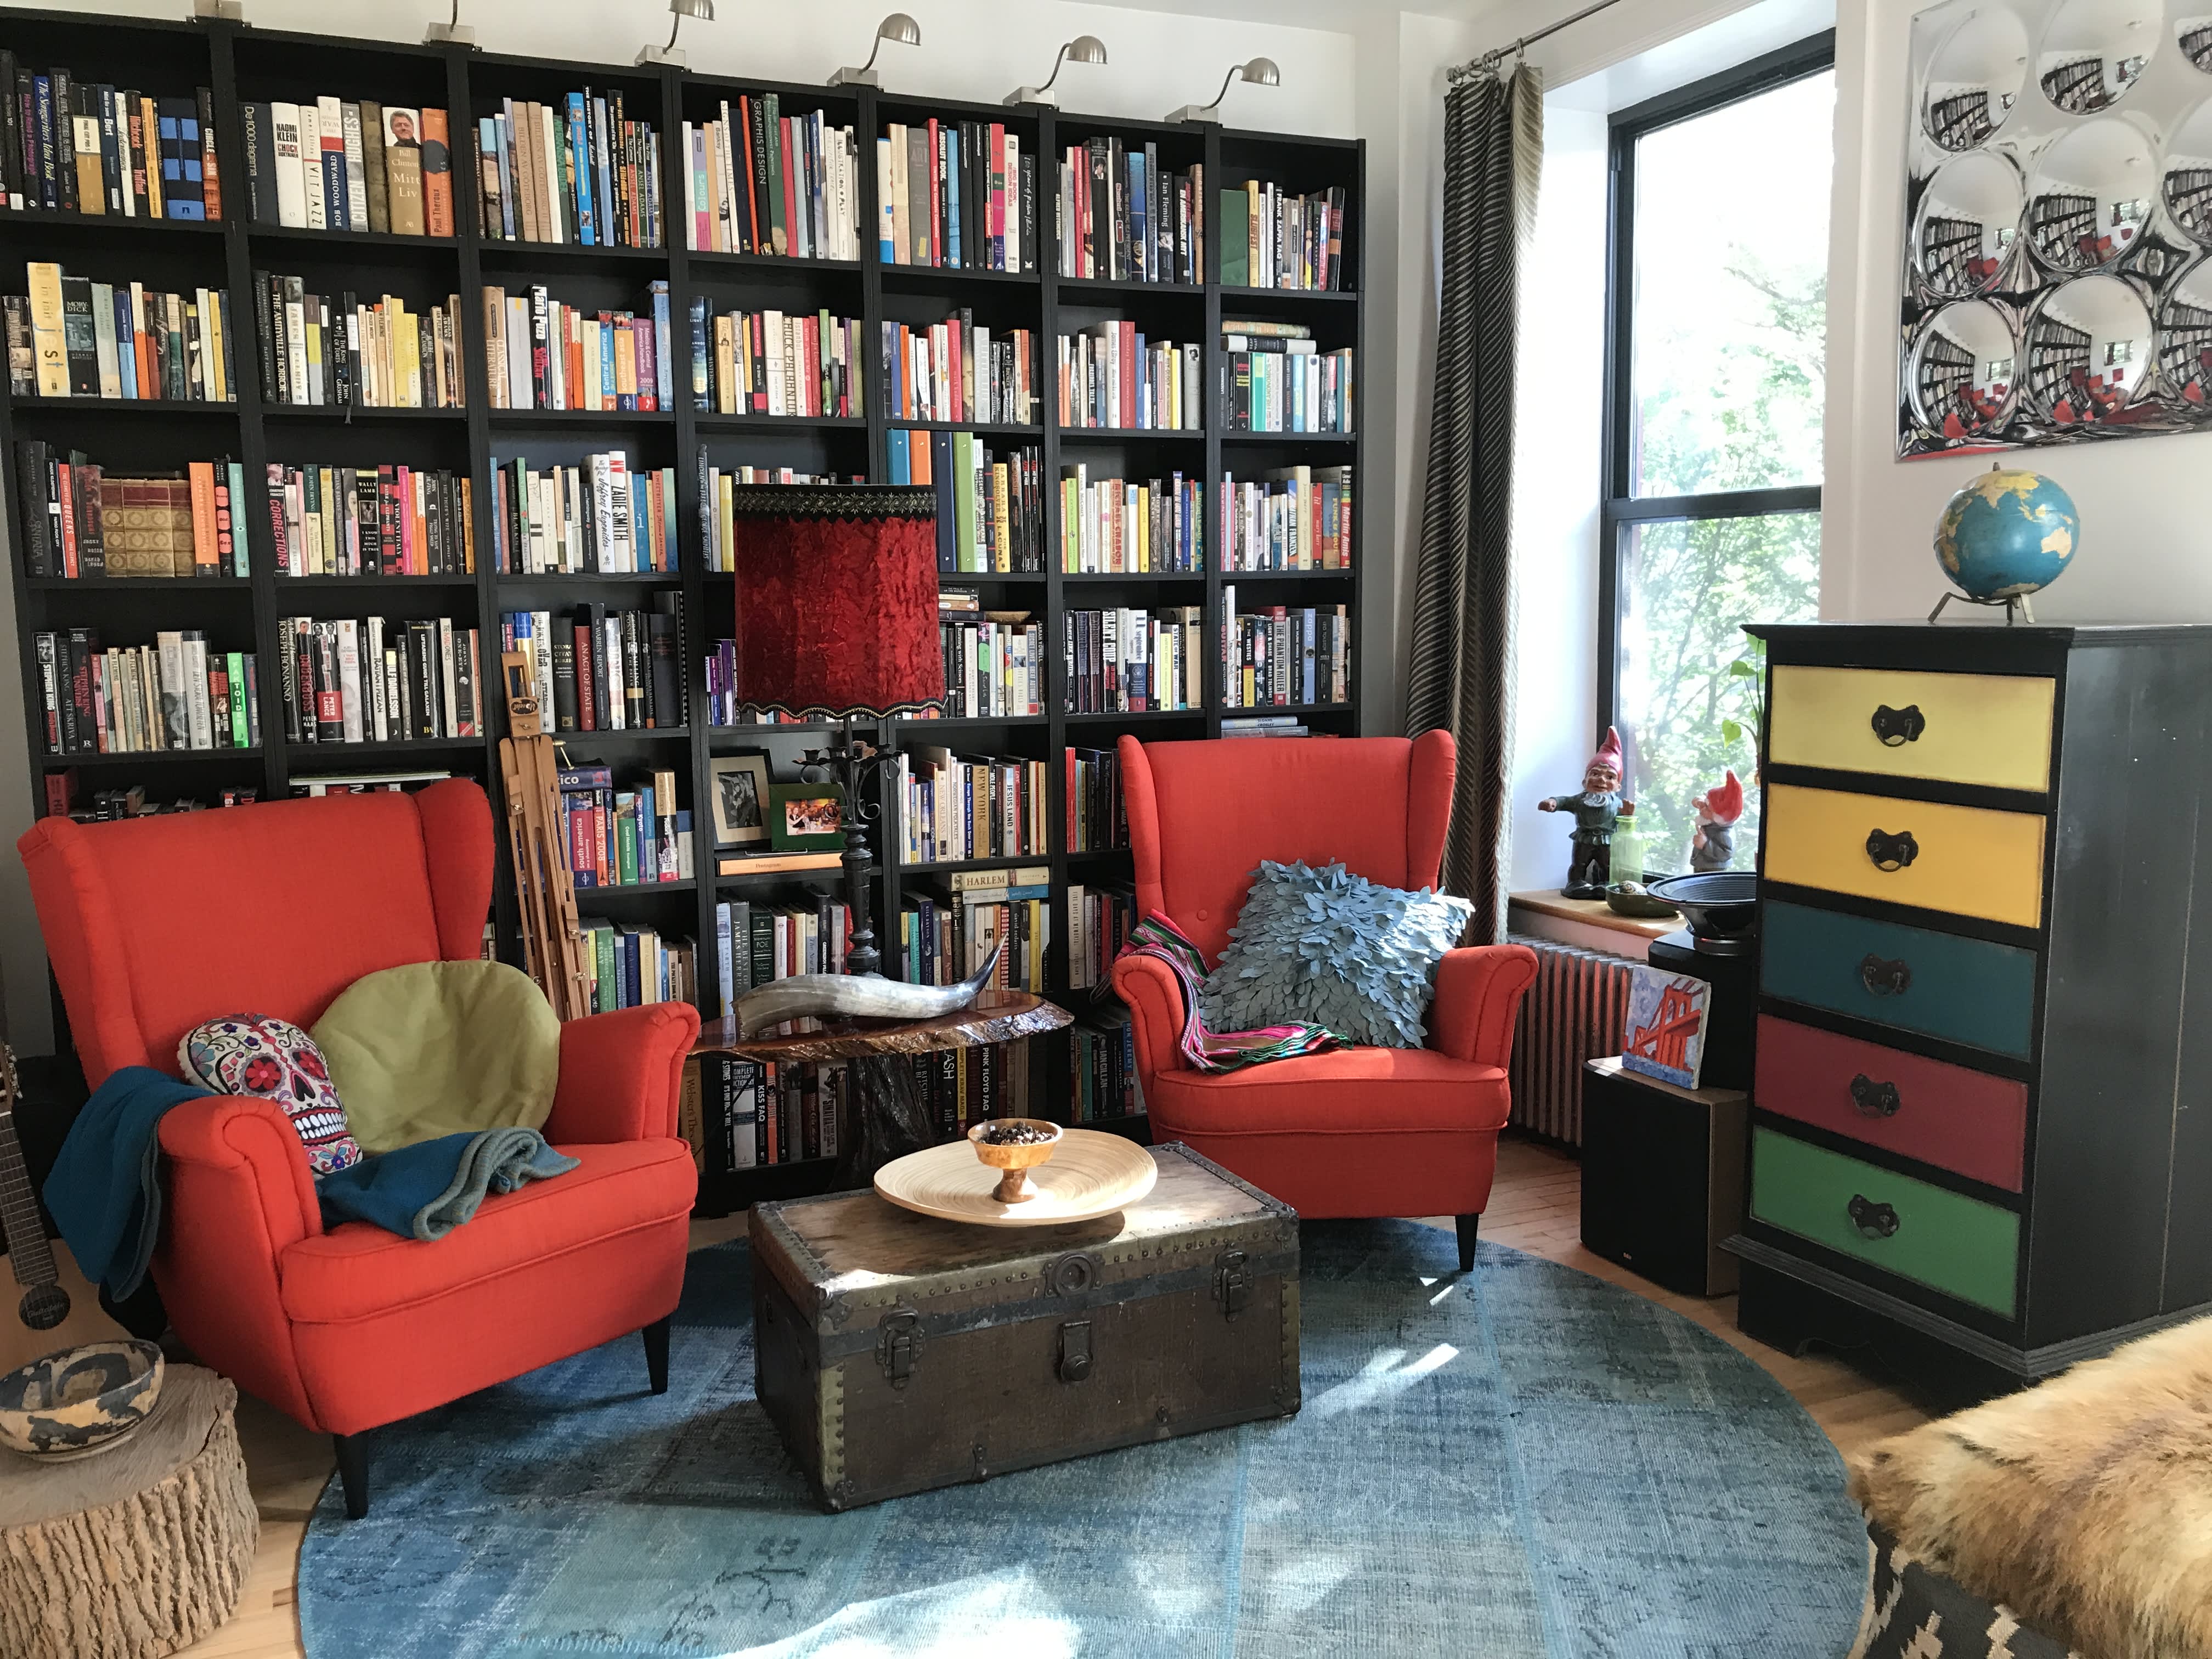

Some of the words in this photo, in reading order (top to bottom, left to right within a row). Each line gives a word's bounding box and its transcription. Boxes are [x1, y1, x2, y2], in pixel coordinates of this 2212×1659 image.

[129, 116, 142, 148] Hitchcock
[754, 102, 764, 144] GRAPHIS
[276, 132, 298, 143] KLEIN
[343, 117, 361, 162] HUGHES
[309, 167, 319, 188] VIT
[758, 147, 766, 184] DESIGN
[134, 169, 145, 195] Truffaut
[330, 156, 340, 206] WOODWARD
[311, 193, 322, 224] JAZZ
[349, 180, 366, 222] CITIZEN
[432, 189, 441, 216] Theroux
[433, 218, 442, 233] Paul
[532, 286, 548, 314] Mario
[532, 316, 548, 340] Puzo
[783, 317, 793, 349] CHUCK
[619, 353, 628, 391] southeast
[785, 356, 795, 416] PALAHNIUK
[610, 460, 625, 473] NW
[597, 478, 608, 506] Jeffrey
[611, 486, 627, 509] ZADIE
[64, 504, 73, 534] QUEENS
[269, 499, 288, 567] CORRECTIONS
[597, 509, 610, 551] Eugenides
[613, 512, 628, 540] SMITH
[1342, 506, 1350, 534] Martin
[278, 620, 289, 654] JOSEPH
[1103, 611, 1116, 640] SILENT
[582, 642, 588, 657] AN
[1103, 642, 1116, 662] COUP
[1133, 631, 1143, 660] september
[1277, 637, 1285, 669] PHANTOM
[43, 664, 53, 693] STEPHEN
[387, 665, 397, 676] ULF
[584, 674, 590, 685] OF
[46, 693, 54, 710] KING
[388, 677, 399, 718] DANIELSSON
[66, 714, 75, 739] SKRIVA
[977, 769, 986, 791] NEW
[977, 795, 986, 821] YORK
[596, 816, 605, 838] PARIS
[597, 841, 606, 861] 2008
[966, 878, 1005, 886] HARLEM
[823, 1100, 834, 1125] SINATRA
